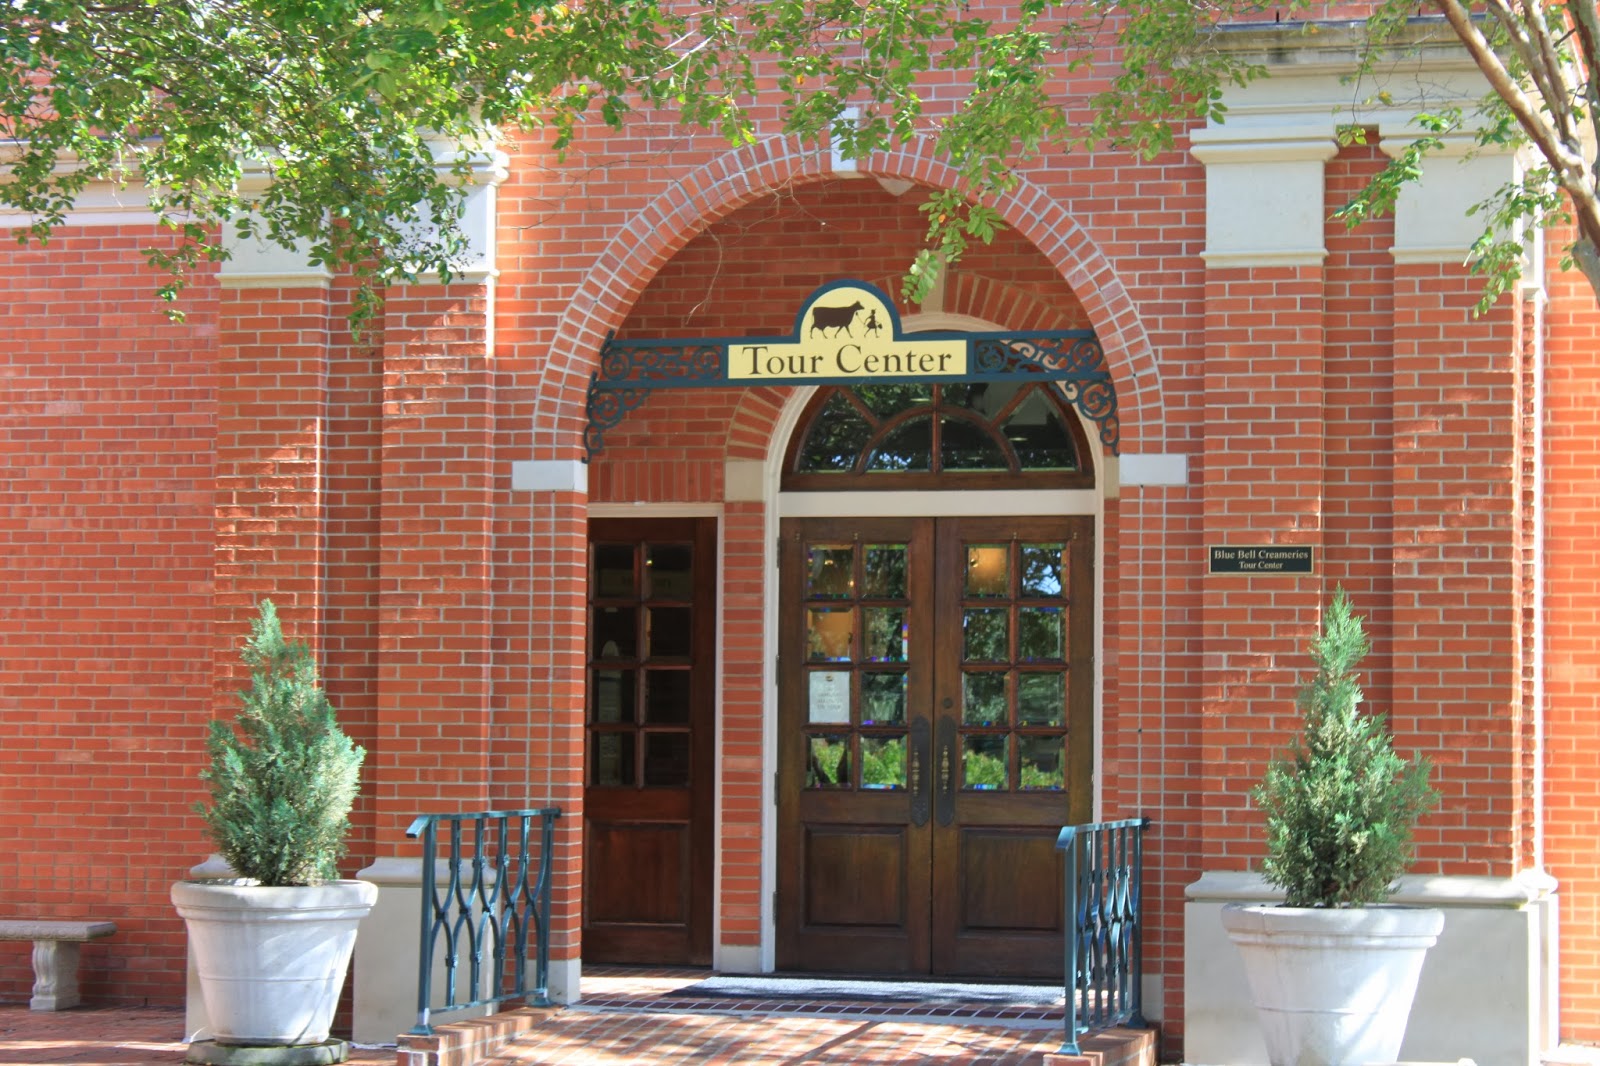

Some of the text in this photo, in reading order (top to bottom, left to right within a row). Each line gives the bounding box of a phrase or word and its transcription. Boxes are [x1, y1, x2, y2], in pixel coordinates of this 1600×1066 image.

[742, 344, 952, 375] Tour Center
[1214, 549, 1308, 559] Blue Bell Creameries
[1239, 561, 1283, 569] Tour Center
